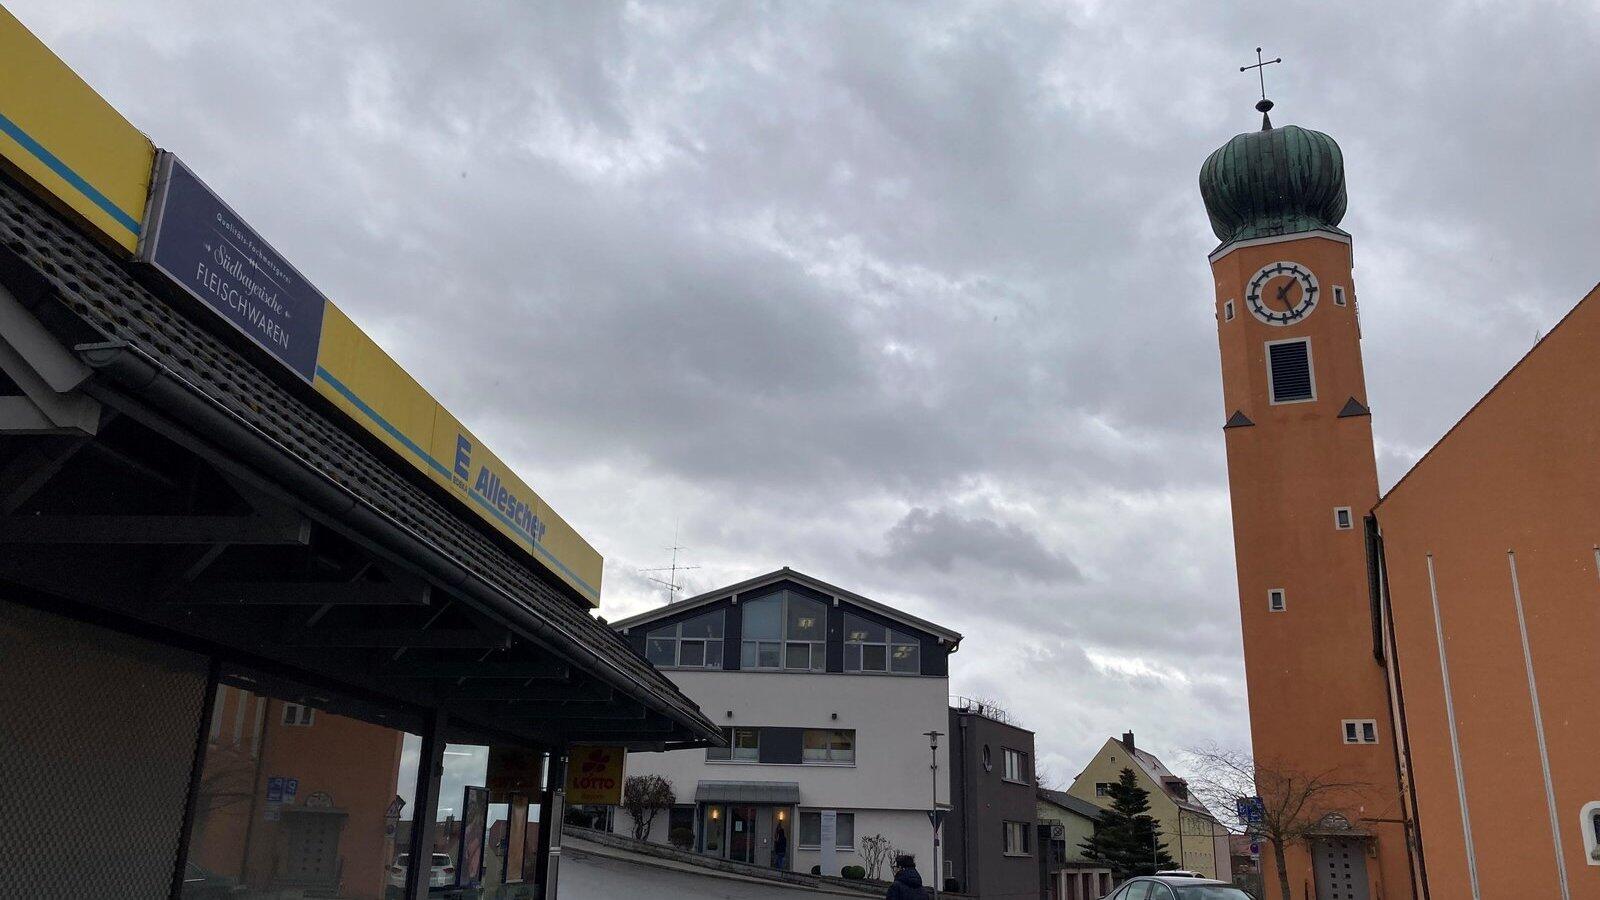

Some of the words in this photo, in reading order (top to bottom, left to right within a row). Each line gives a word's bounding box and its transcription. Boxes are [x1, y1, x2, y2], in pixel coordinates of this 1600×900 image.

[196, 262, 289, 348] FLEISCHWAREN
[213, 244, 283, 315] Südbayerische
[475, 465, 546, 541] Allescher
[573, 776, 615, 789] LOTTO
